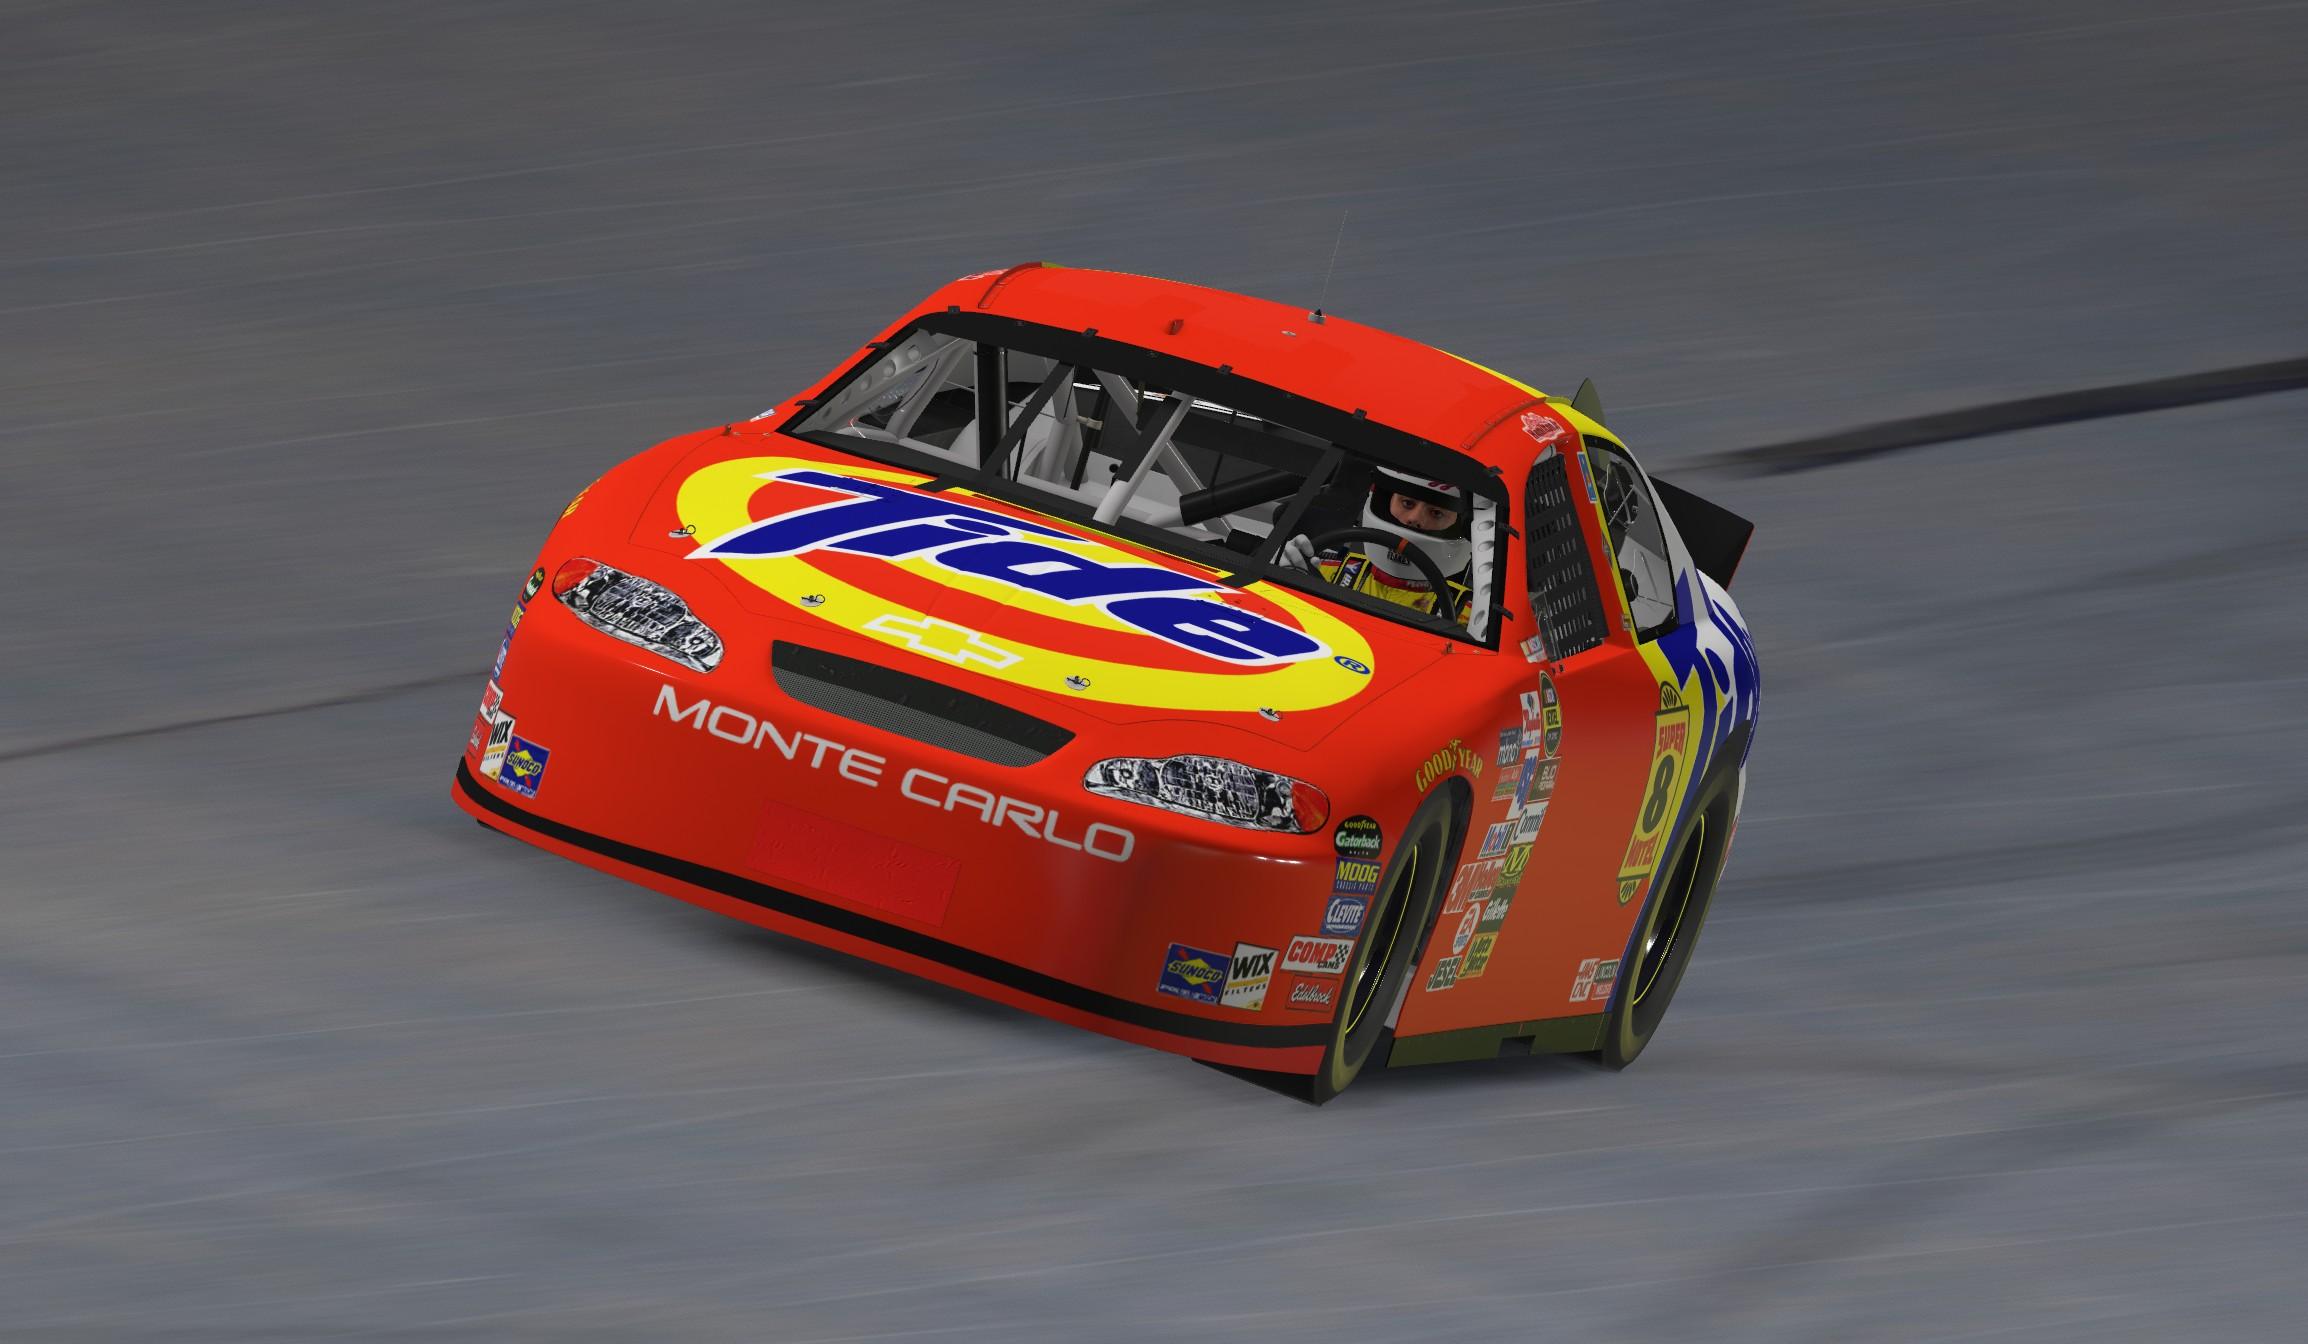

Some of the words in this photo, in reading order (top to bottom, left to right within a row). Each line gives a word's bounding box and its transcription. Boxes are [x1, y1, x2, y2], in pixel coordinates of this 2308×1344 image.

[684, 467, 1332, 666] Tide
[489, 720, 513, 746] WIX
[507, 753, 541, 776] SUNOCO
[652, 684, 887, 787] MONTE
[901, 768, 1136, 863] CARLO
[1642, 754, 1675, 834] 8
[1335, 830, 1381, 849] Gatorback
[1336, 860, 1380, 884] MOOG
[1326, 898, 1364, 924] CLEVITE
[1287, 940, 1337, 963] COMP
[1169, 961, 1223, 981] SUNOCO
[1232, 952, 1275, 980] WIX
